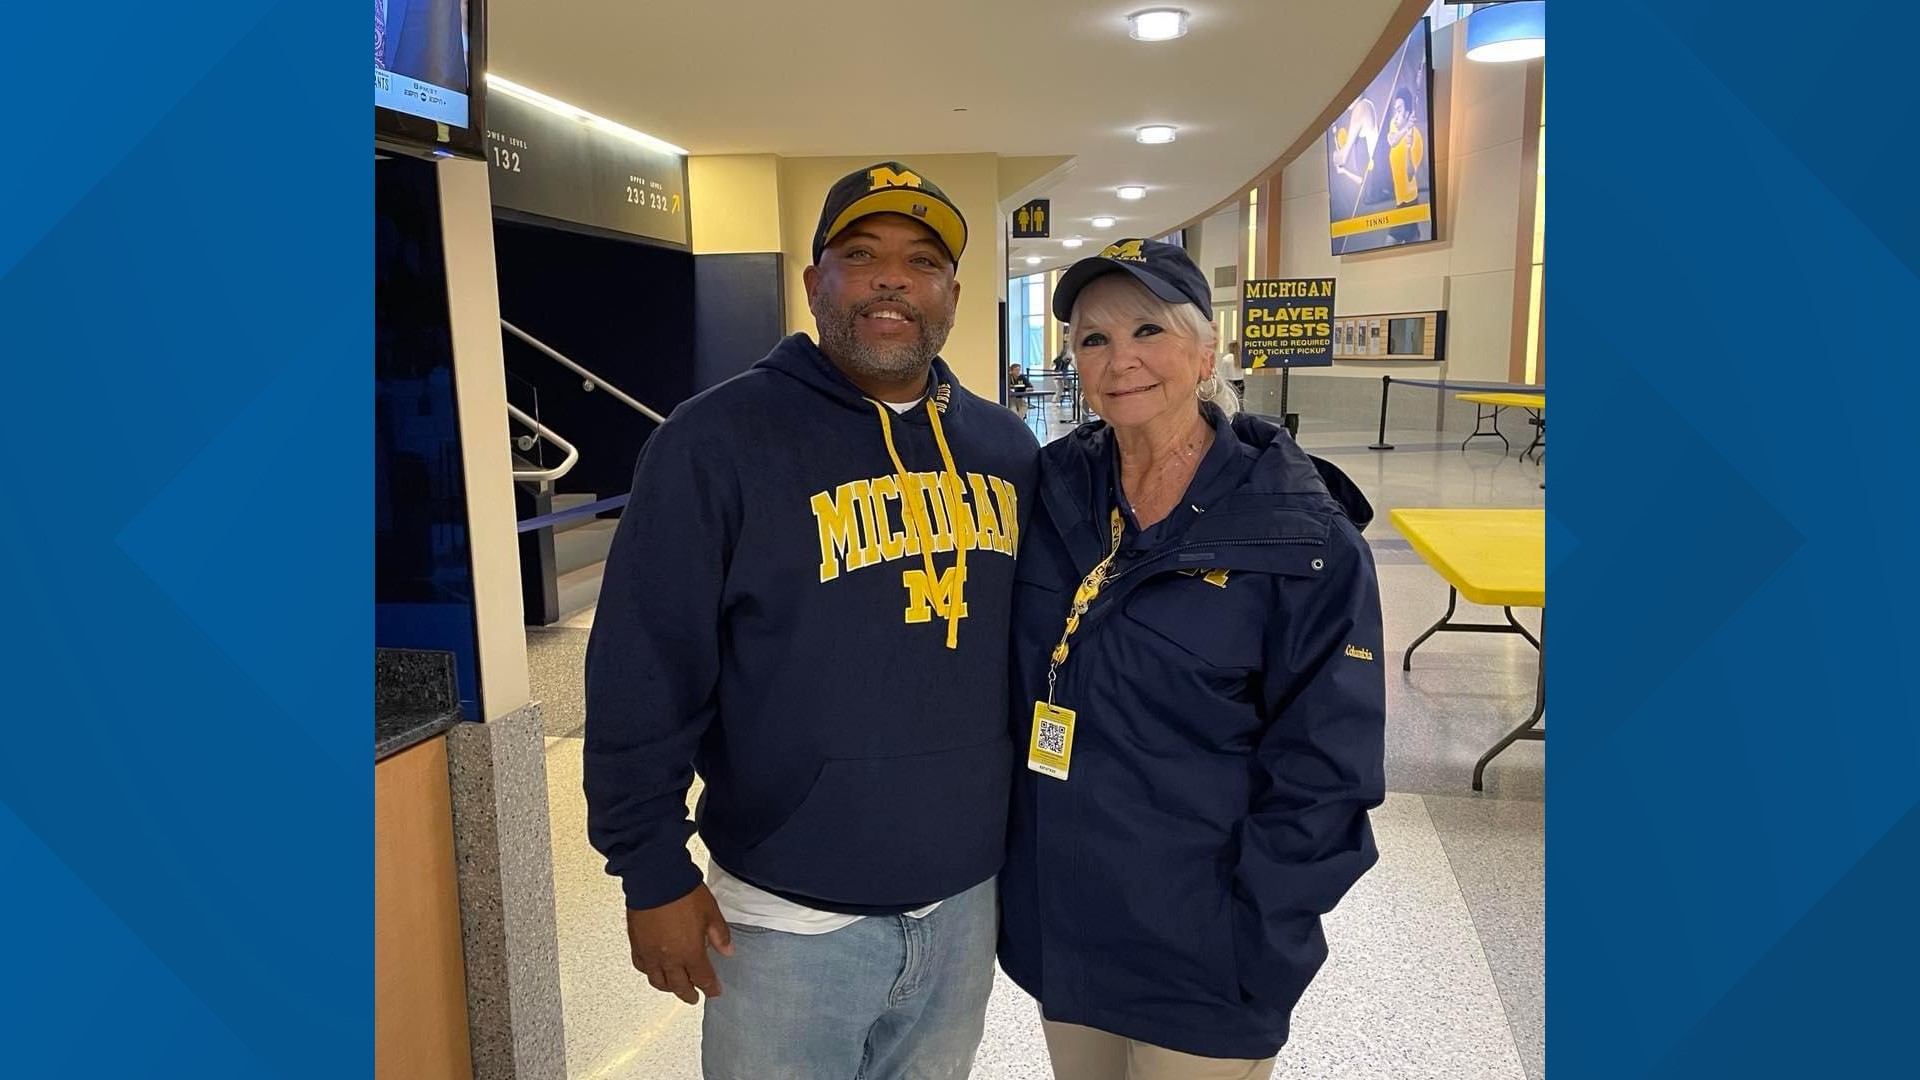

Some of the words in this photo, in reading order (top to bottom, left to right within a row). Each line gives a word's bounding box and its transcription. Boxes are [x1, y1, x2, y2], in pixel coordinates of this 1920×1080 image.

[509, 137, 528, 150] LEVEL
[493, 146, 521, 172] 132
[630, 175, 645, 185] UPPER
[870, 166, 922, 191] M
[626, 186, 645, 206] 233
[650, 193, 668, 212] 232
[1366, 215, 1390, 228] TENNIS
[1246, 281, 1333, 299] MICHIGAN
[1248, 306, 1329, 322] PLAYER
[1245, 322, 1330, 338] GUESTS
[1244, 340, 1278, 348] PICTURE
[1290, 339, 1331, 347] REQUIRED
[1248, 348, 1264, 356] FOR
[1297, 347, 1326, 355] PICKUP
[810, 471, 1018, 583] MICHIGAN
[902, 566, 968, 624] M
[1344, 644, 1373, 661] Columbia
